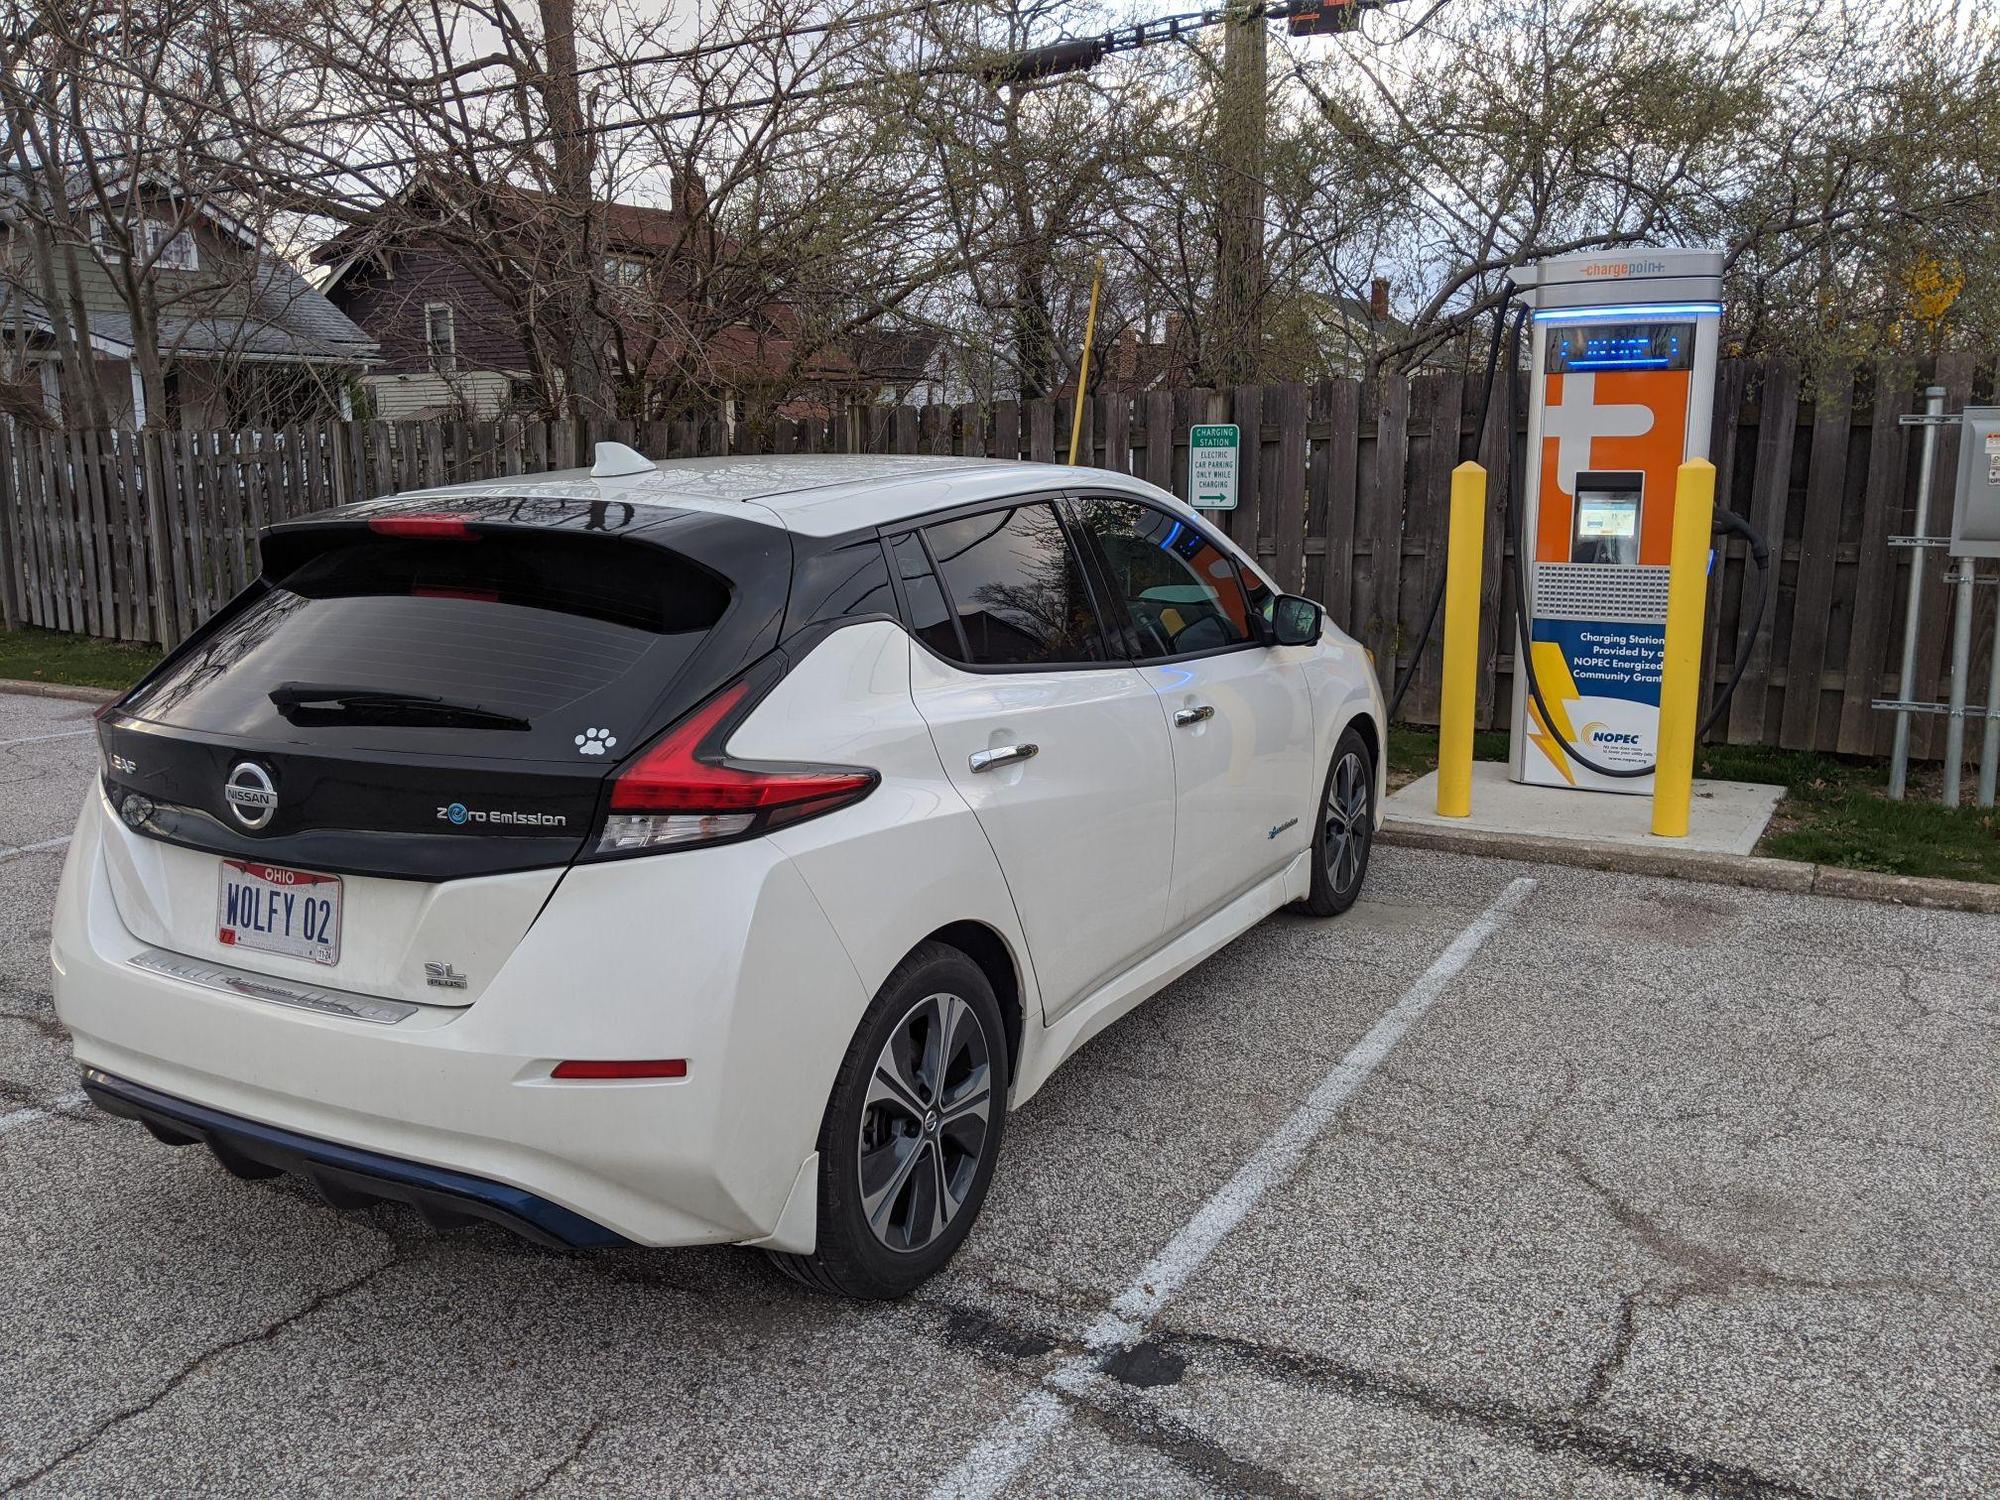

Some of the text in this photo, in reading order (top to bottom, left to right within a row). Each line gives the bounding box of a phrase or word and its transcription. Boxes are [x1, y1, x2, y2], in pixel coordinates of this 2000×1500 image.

[1196, 428, 1233, 437] CHARGING
[1200, 438, 1229, 446] STATION
[1200, 451, 1228, 459] ELECTRIC
[1208, 460, 1233, 468] PARKING
[1580, 632, 1665, 645] Charging Station
[1593, 646, 1639, 657] Provided
[1641, 646, 1655, 660] by
[1574, 657, 1664, 672] NOPEC Energized
[1573, 669, 1663, 684] Community Grant
[1593, 731, 1640, 744] NOPEC
[227, 789, 270, 804] NISSAN
[489, 811, 567, 826] Emission
[264, 867, 295, 884] OHIO
[226, 882, 331, 944] WOLFY 02
[424, 961, 466, 978] SL
